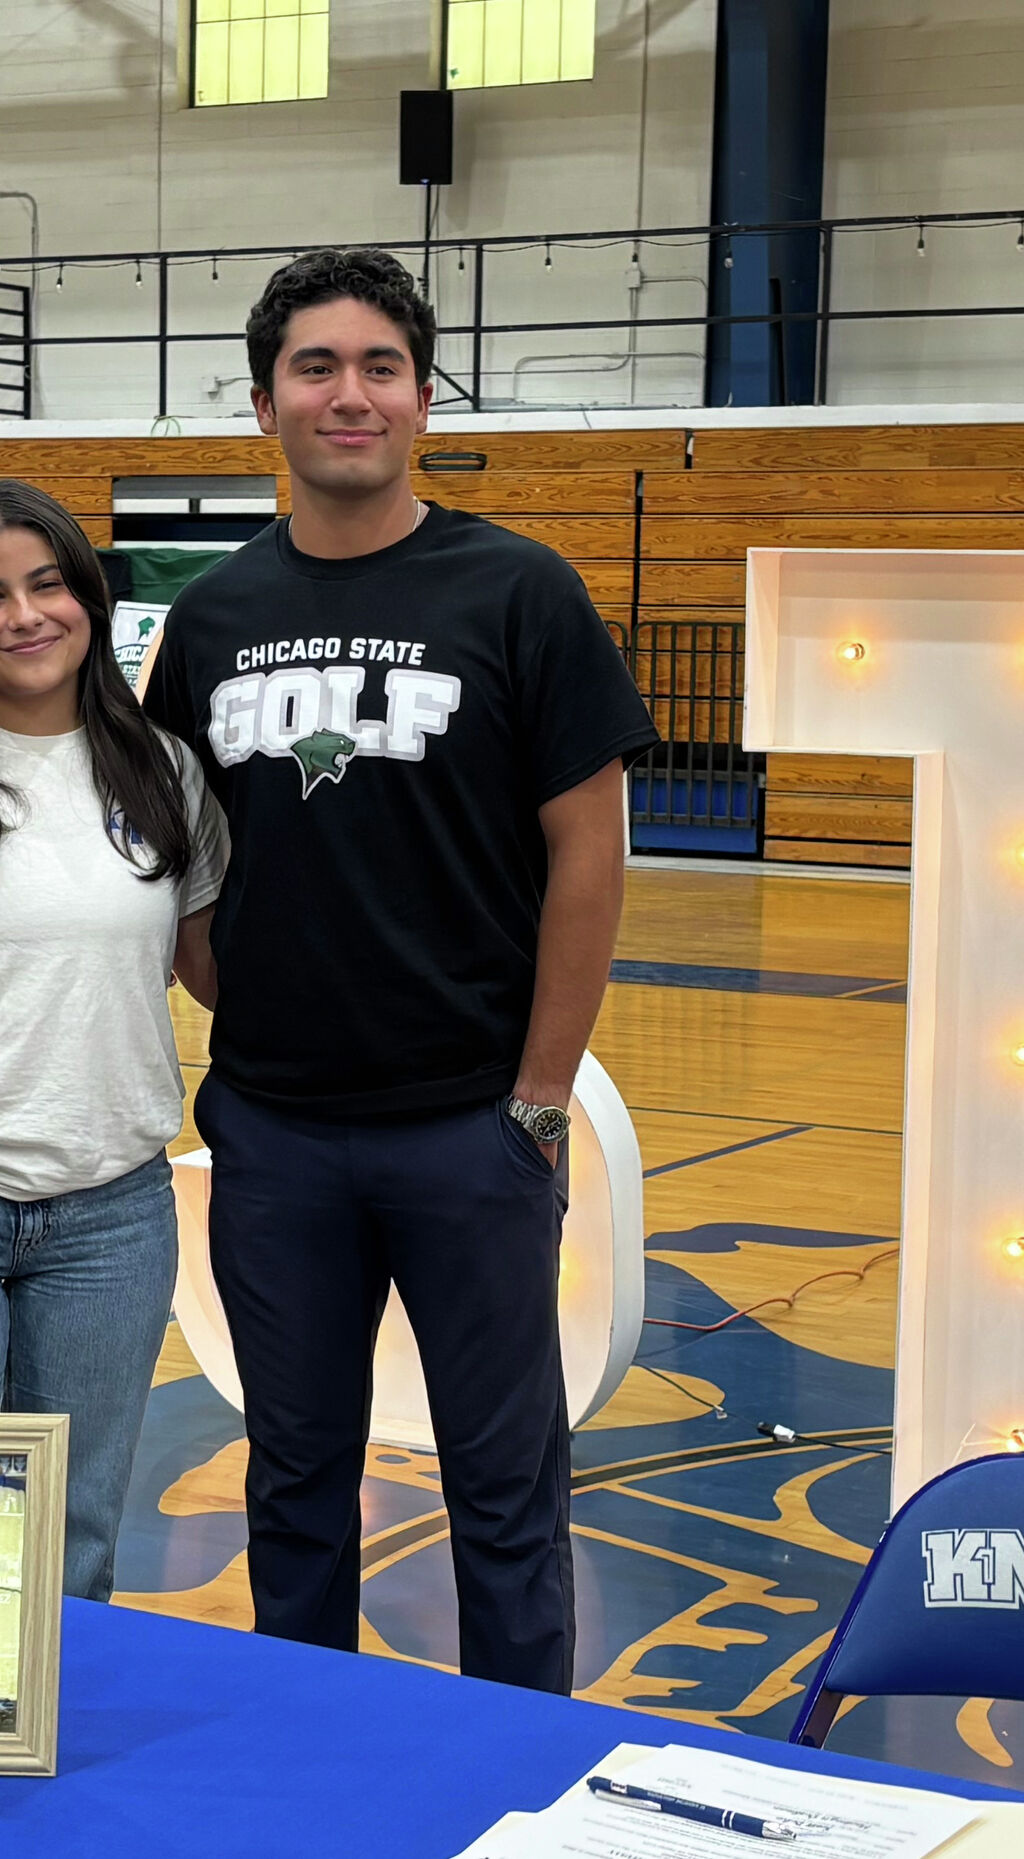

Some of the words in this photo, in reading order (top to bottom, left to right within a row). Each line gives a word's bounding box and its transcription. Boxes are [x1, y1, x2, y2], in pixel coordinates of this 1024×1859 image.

[236, 637, 341, 671] CHICAGO
[349, 637, 426, 666] STATE
[208, 666, 461, 768] GOLF
